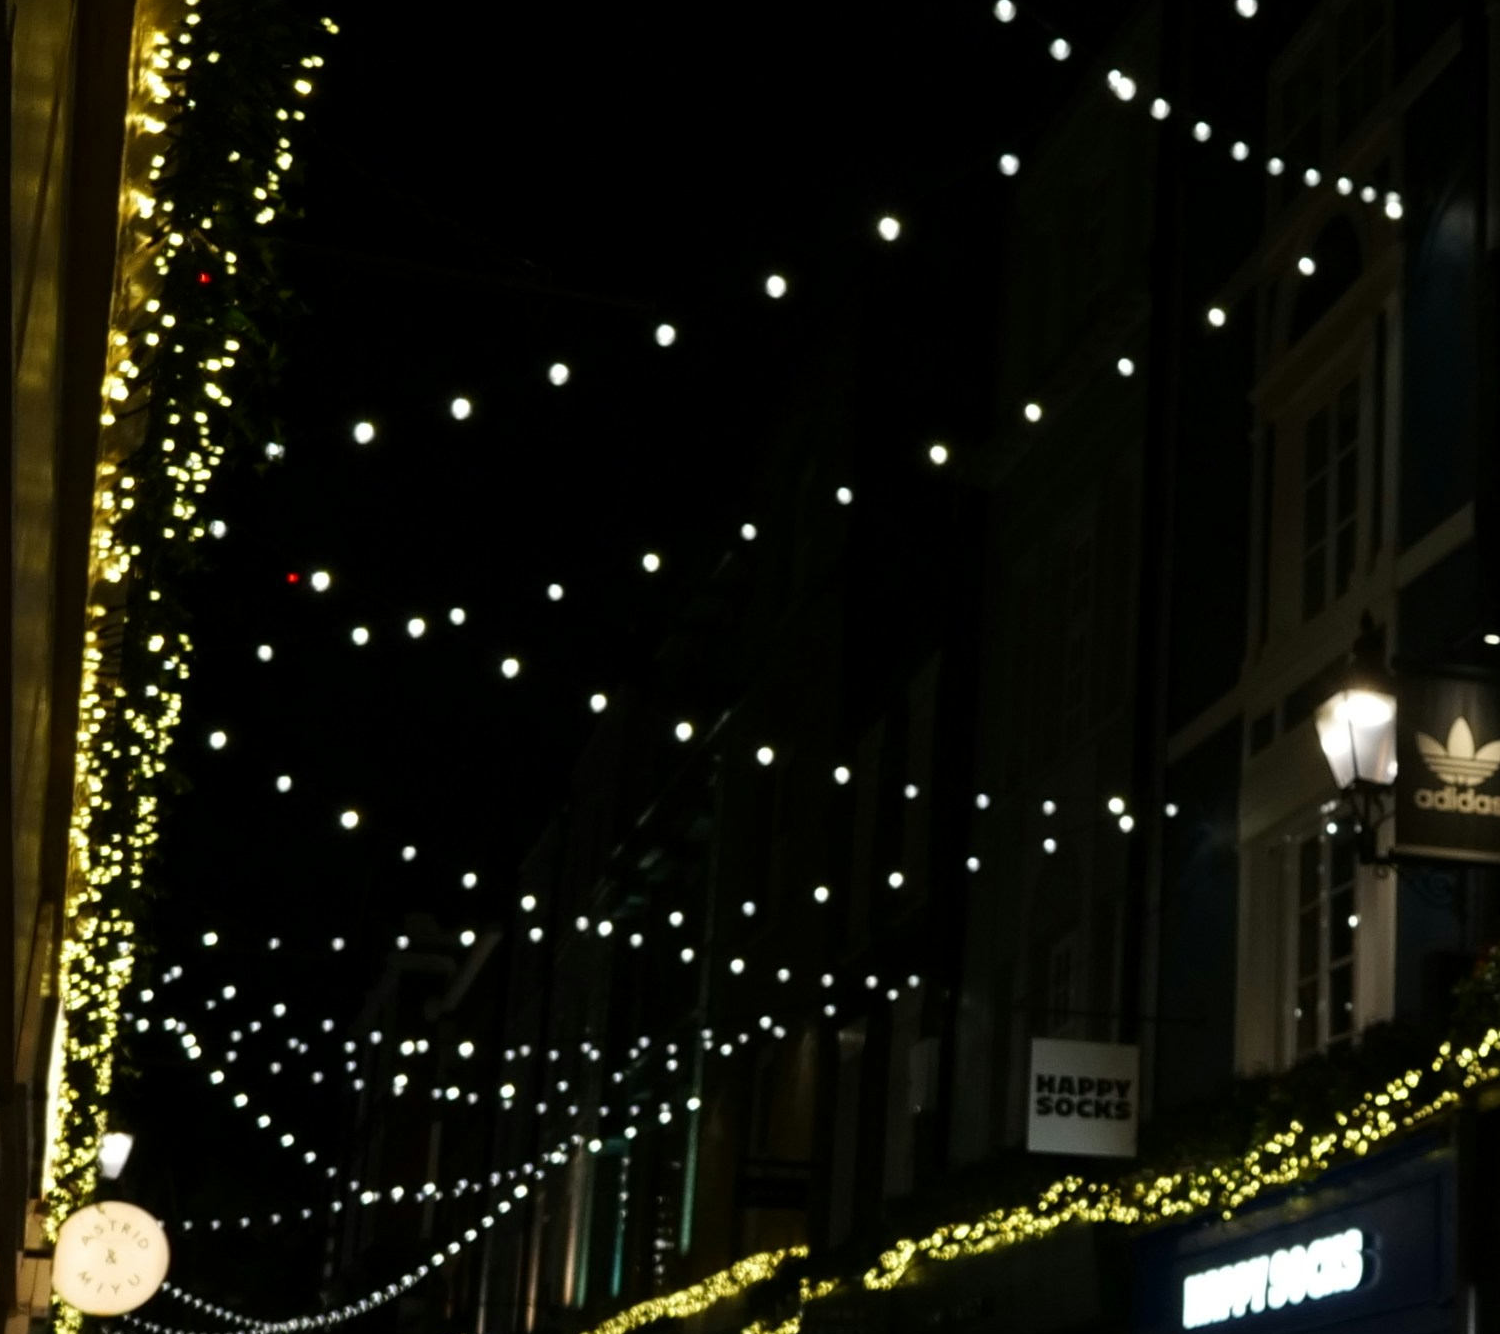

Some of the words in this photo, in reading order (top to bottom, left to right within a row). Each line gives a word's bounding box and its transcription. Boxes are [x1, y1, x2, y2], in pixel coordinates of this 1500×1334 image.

[1036, 1074, 1132, 1099] HAPPY
[1036, 1095, 1132, 1121] SOCKS
[81, 1220, 150, 1249] ASTRID
[104, 1248, 117, 1265] &
[78, 1271, 142, 1295] MIYU
